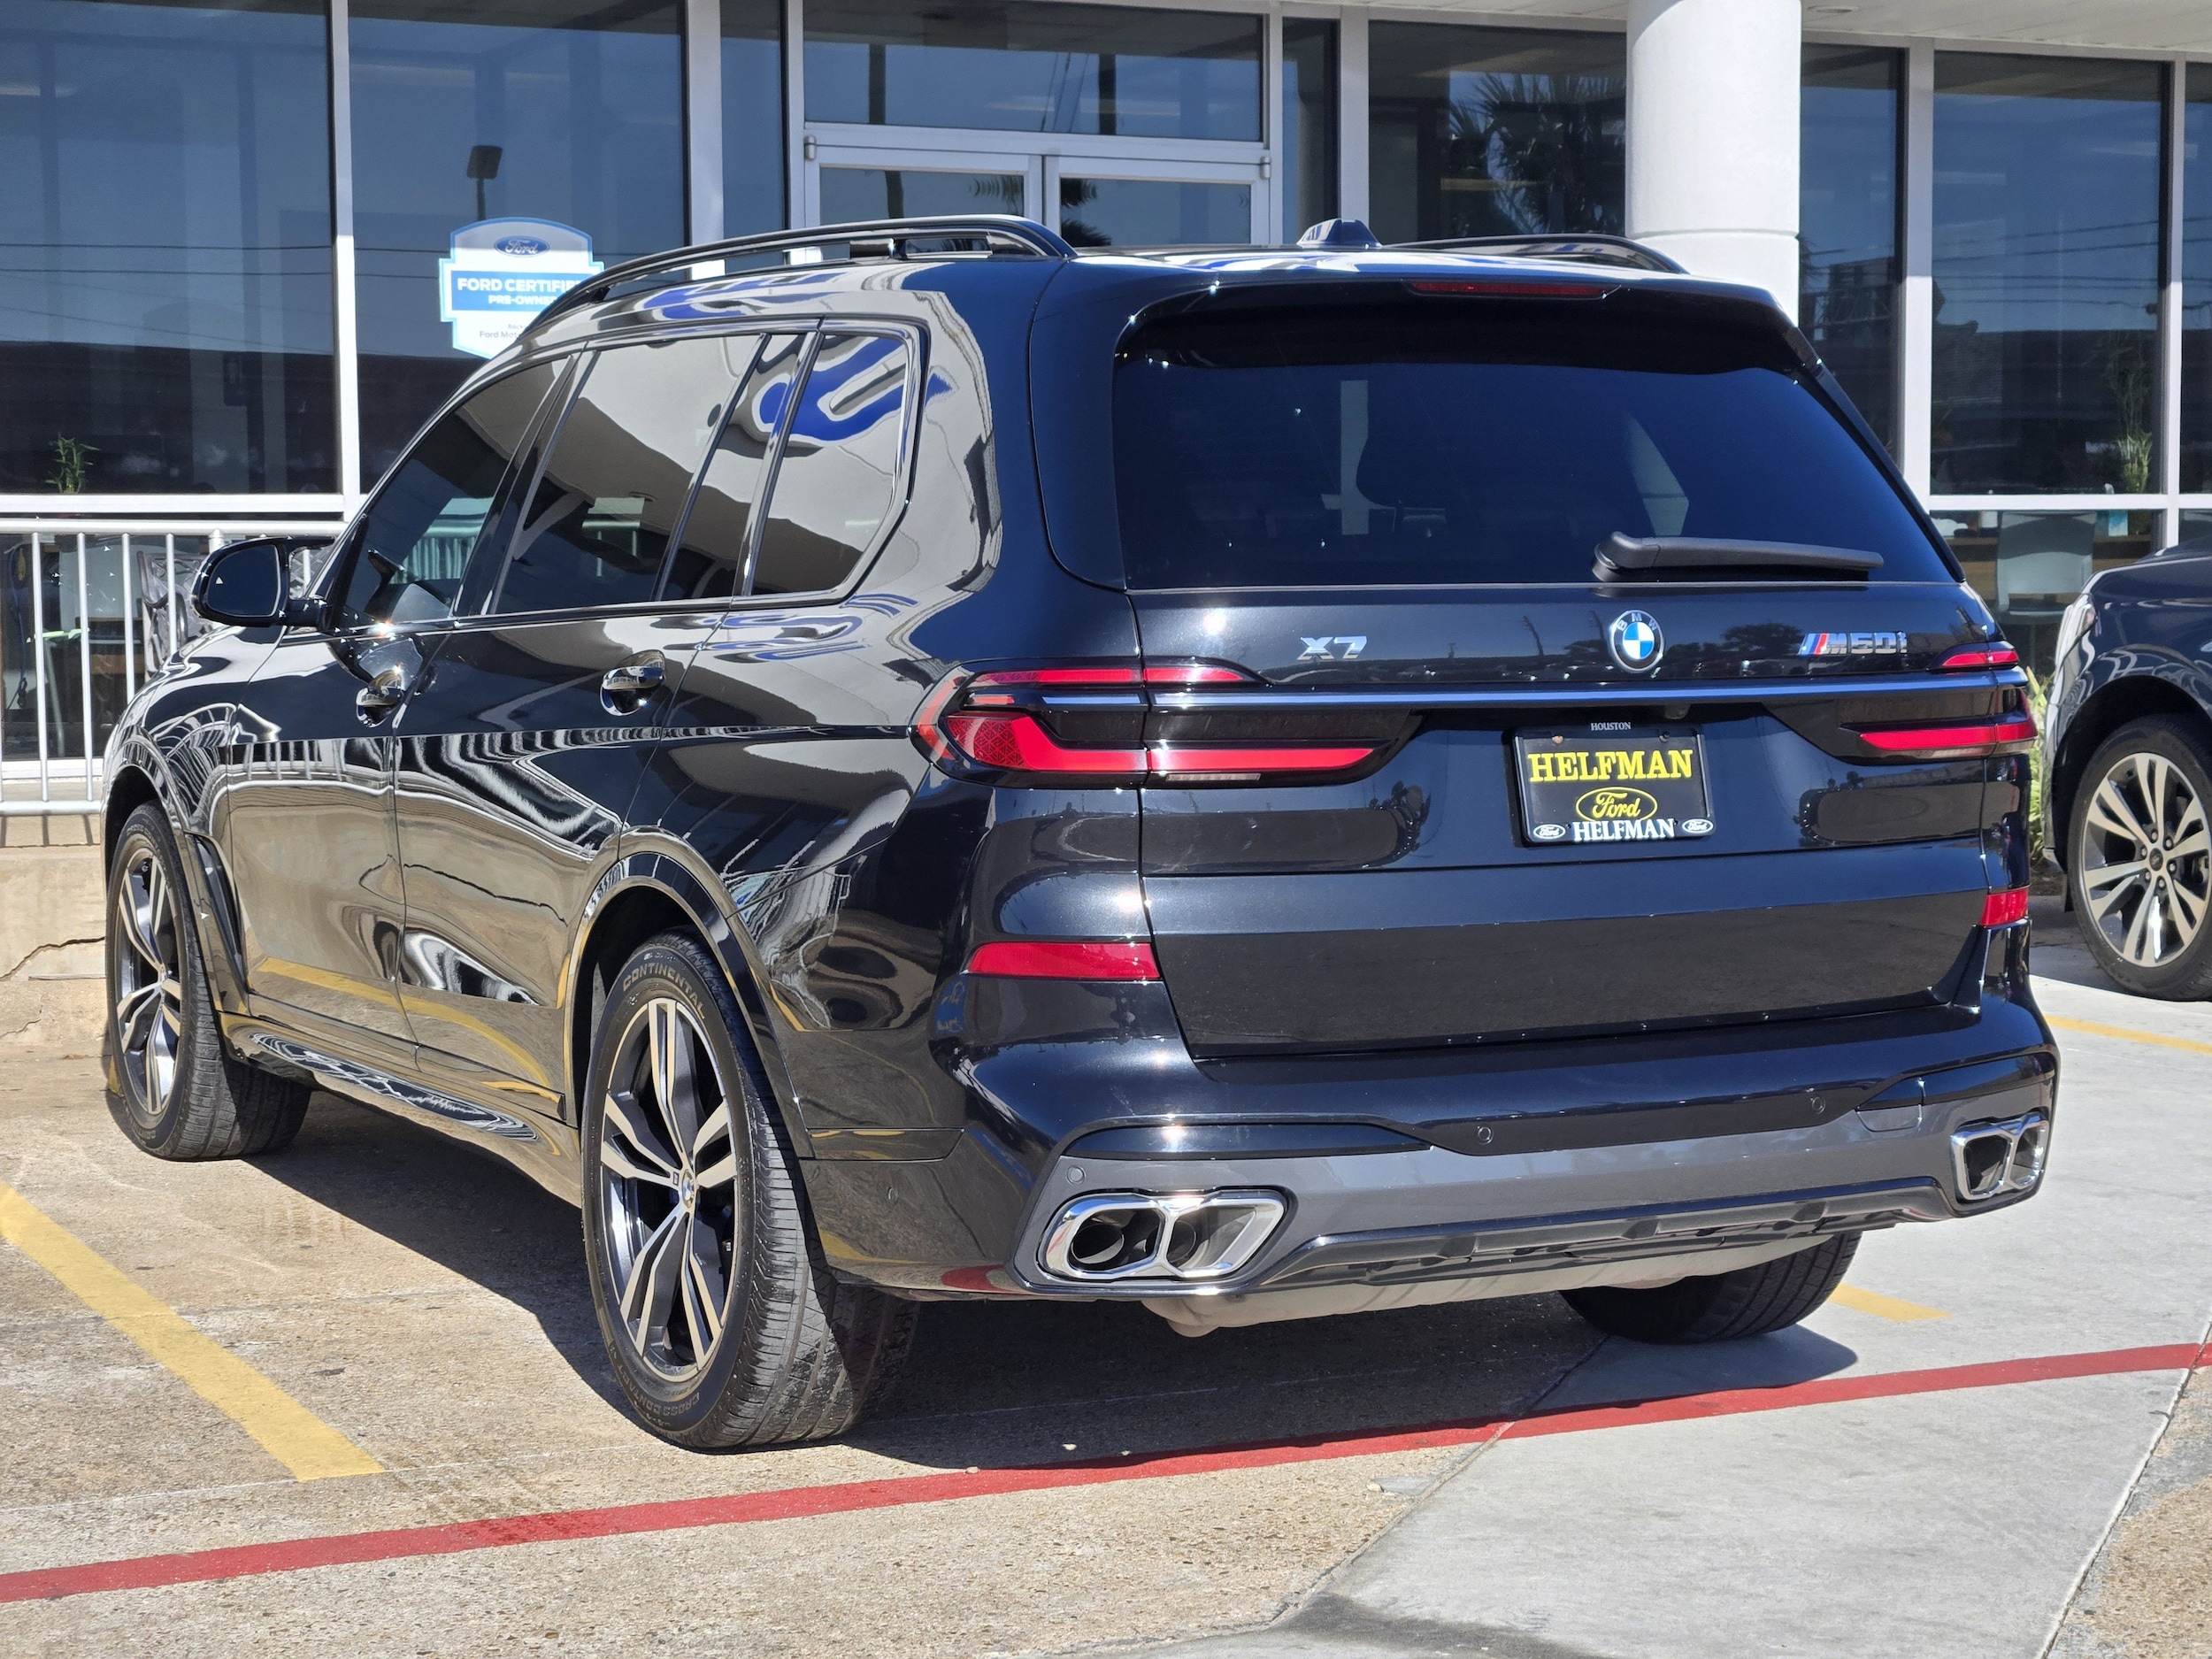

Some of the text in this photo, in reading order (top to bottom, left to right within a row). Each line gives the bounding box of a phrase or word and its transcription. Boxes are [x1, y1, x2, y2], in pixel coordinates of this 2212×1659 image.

[505, 240, 539, 255] Ford
[457, 277, 582, 293] FORD CERTIFIE
[1617, 612, 1658, 631] BMW
[1297, 635, 1368, 660] X7
[1590, 722, 1632, 731] HOUSTON
[1527, 749, 1694, 782] HELFMAN
[1593, 792, 1641, 818] Ford
[1572, 818, 1675, 841] HELFMAN
[623, 962, 705, 1019] CONTINENTAL
